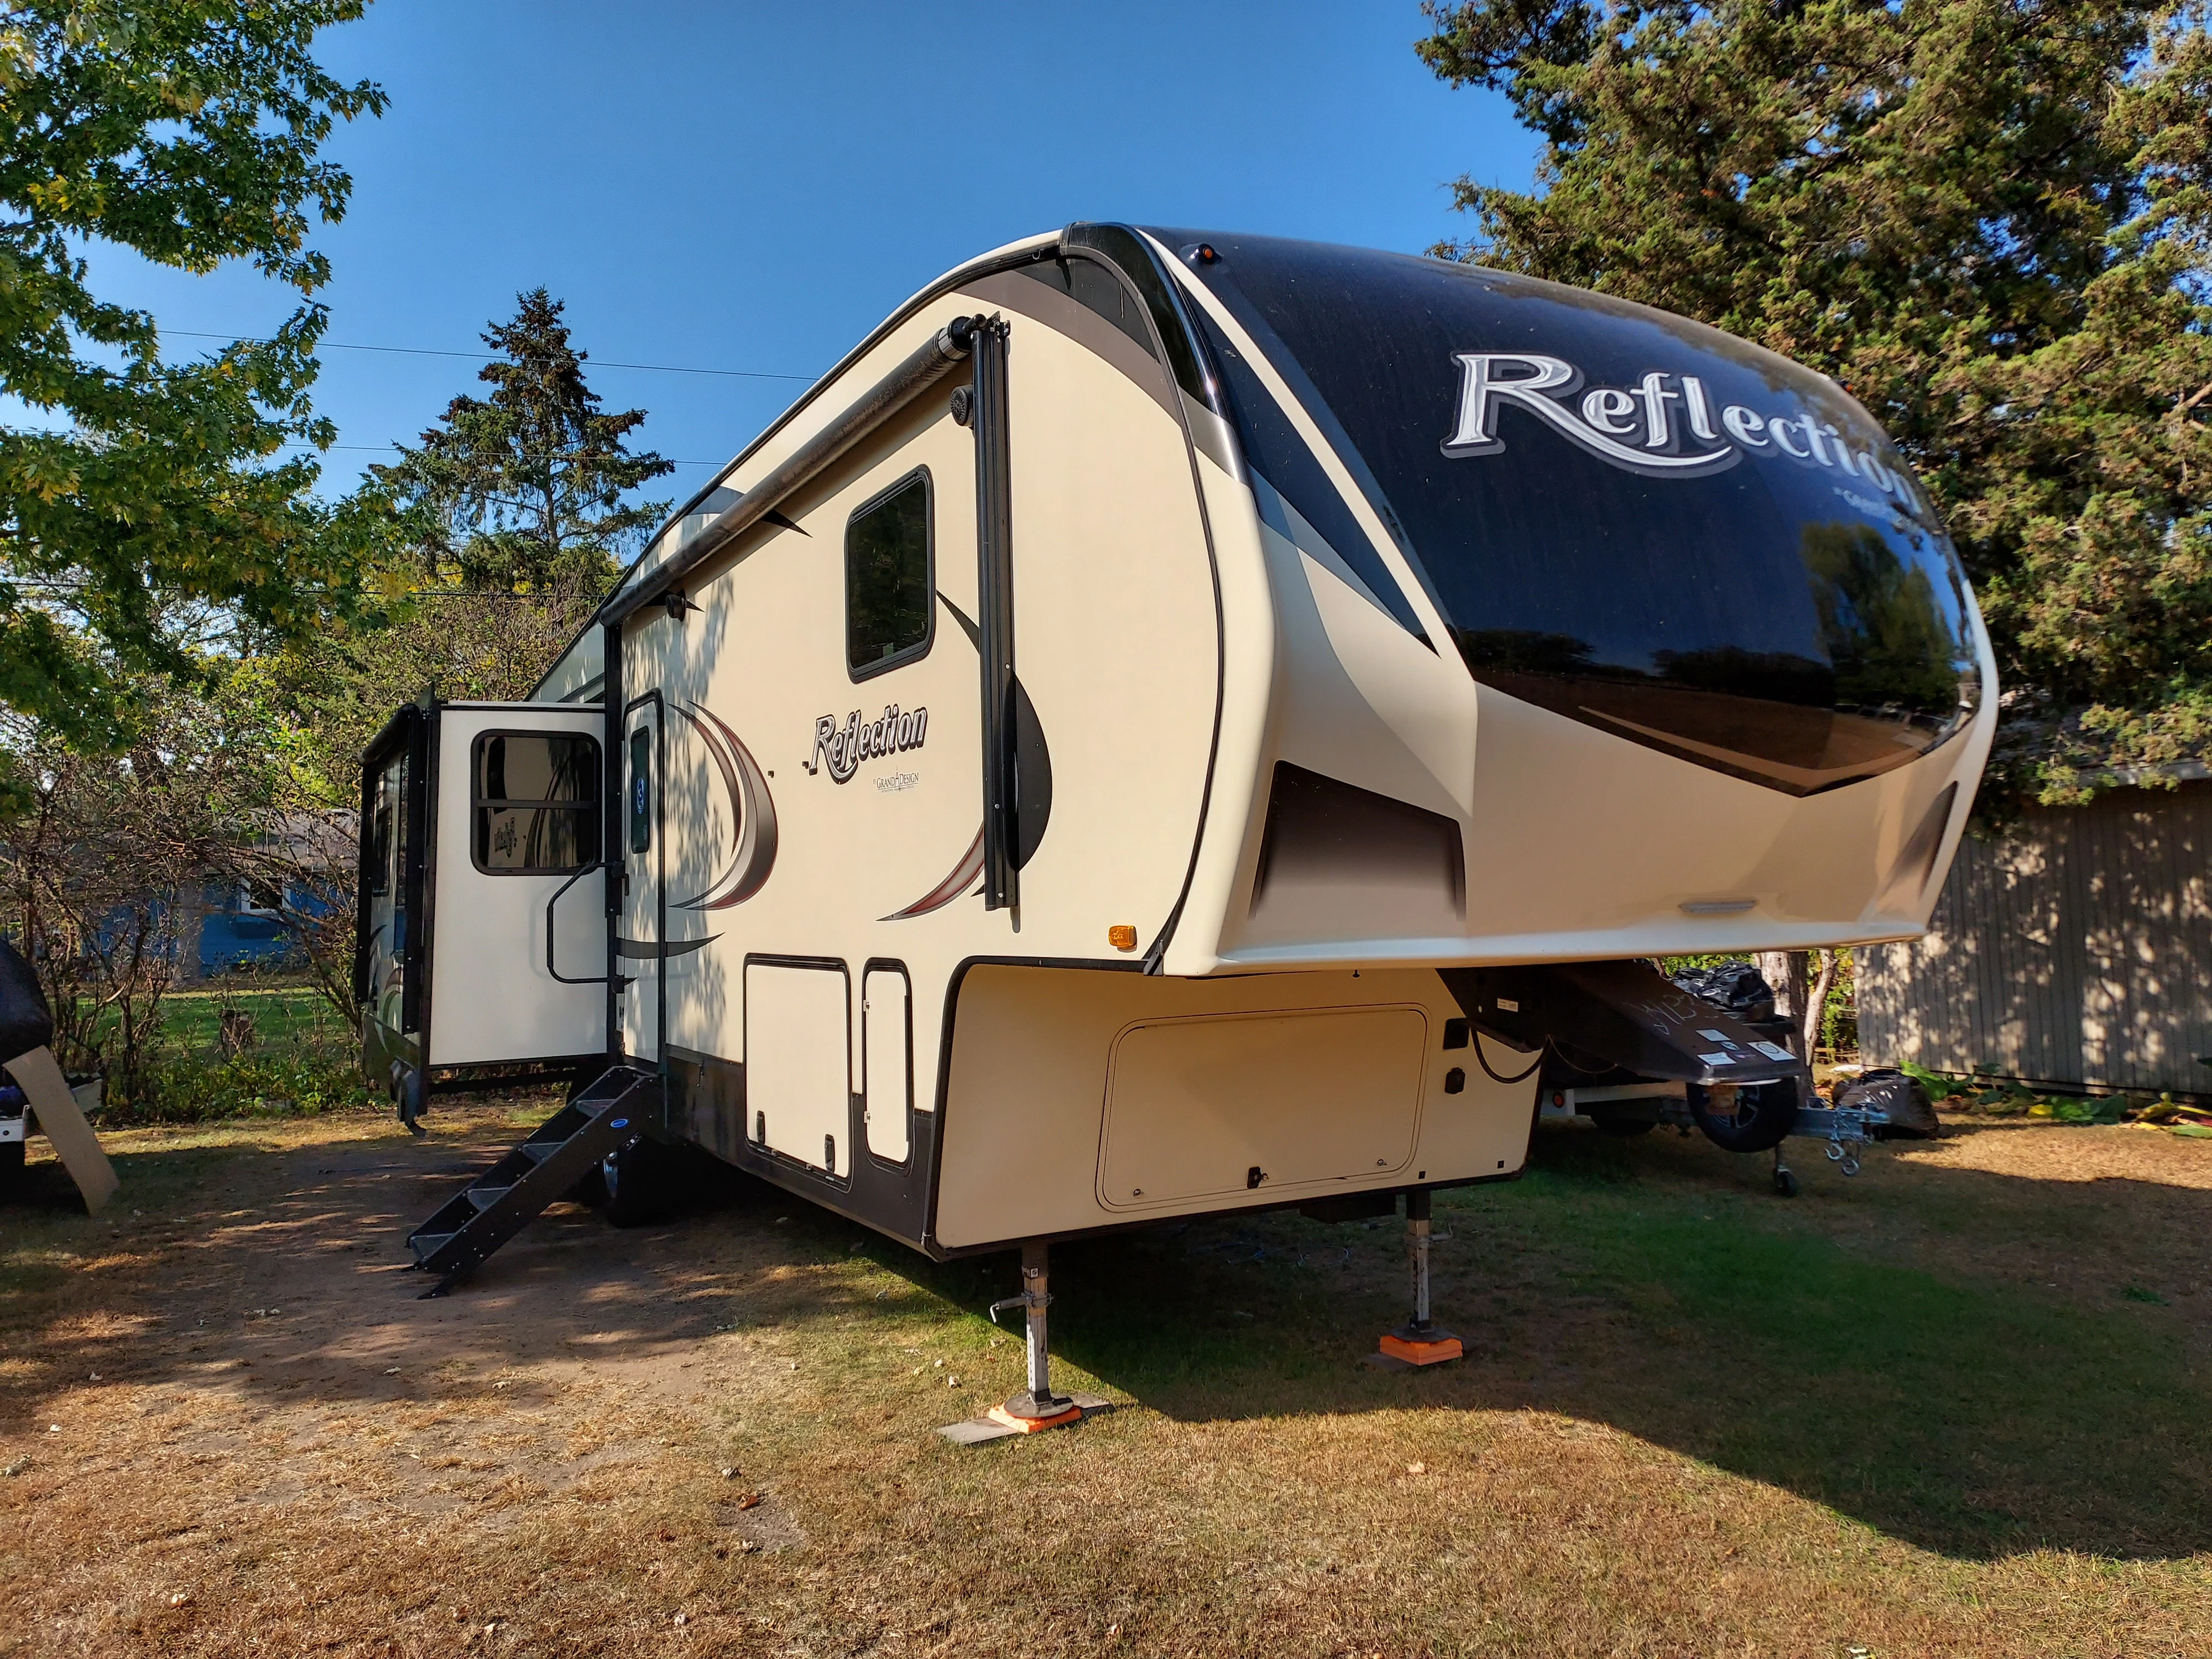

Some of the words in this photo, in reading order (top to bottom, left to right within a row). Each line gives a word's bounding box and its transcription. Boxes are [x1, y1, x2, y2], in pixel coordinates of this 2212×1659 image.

[1440, 350, 1923, 514] Reflection
[808, 703, 929, 785] Reflection
[877, 776, 895, 789] GRAND
[899, 772, 919, 785] DESIGN
